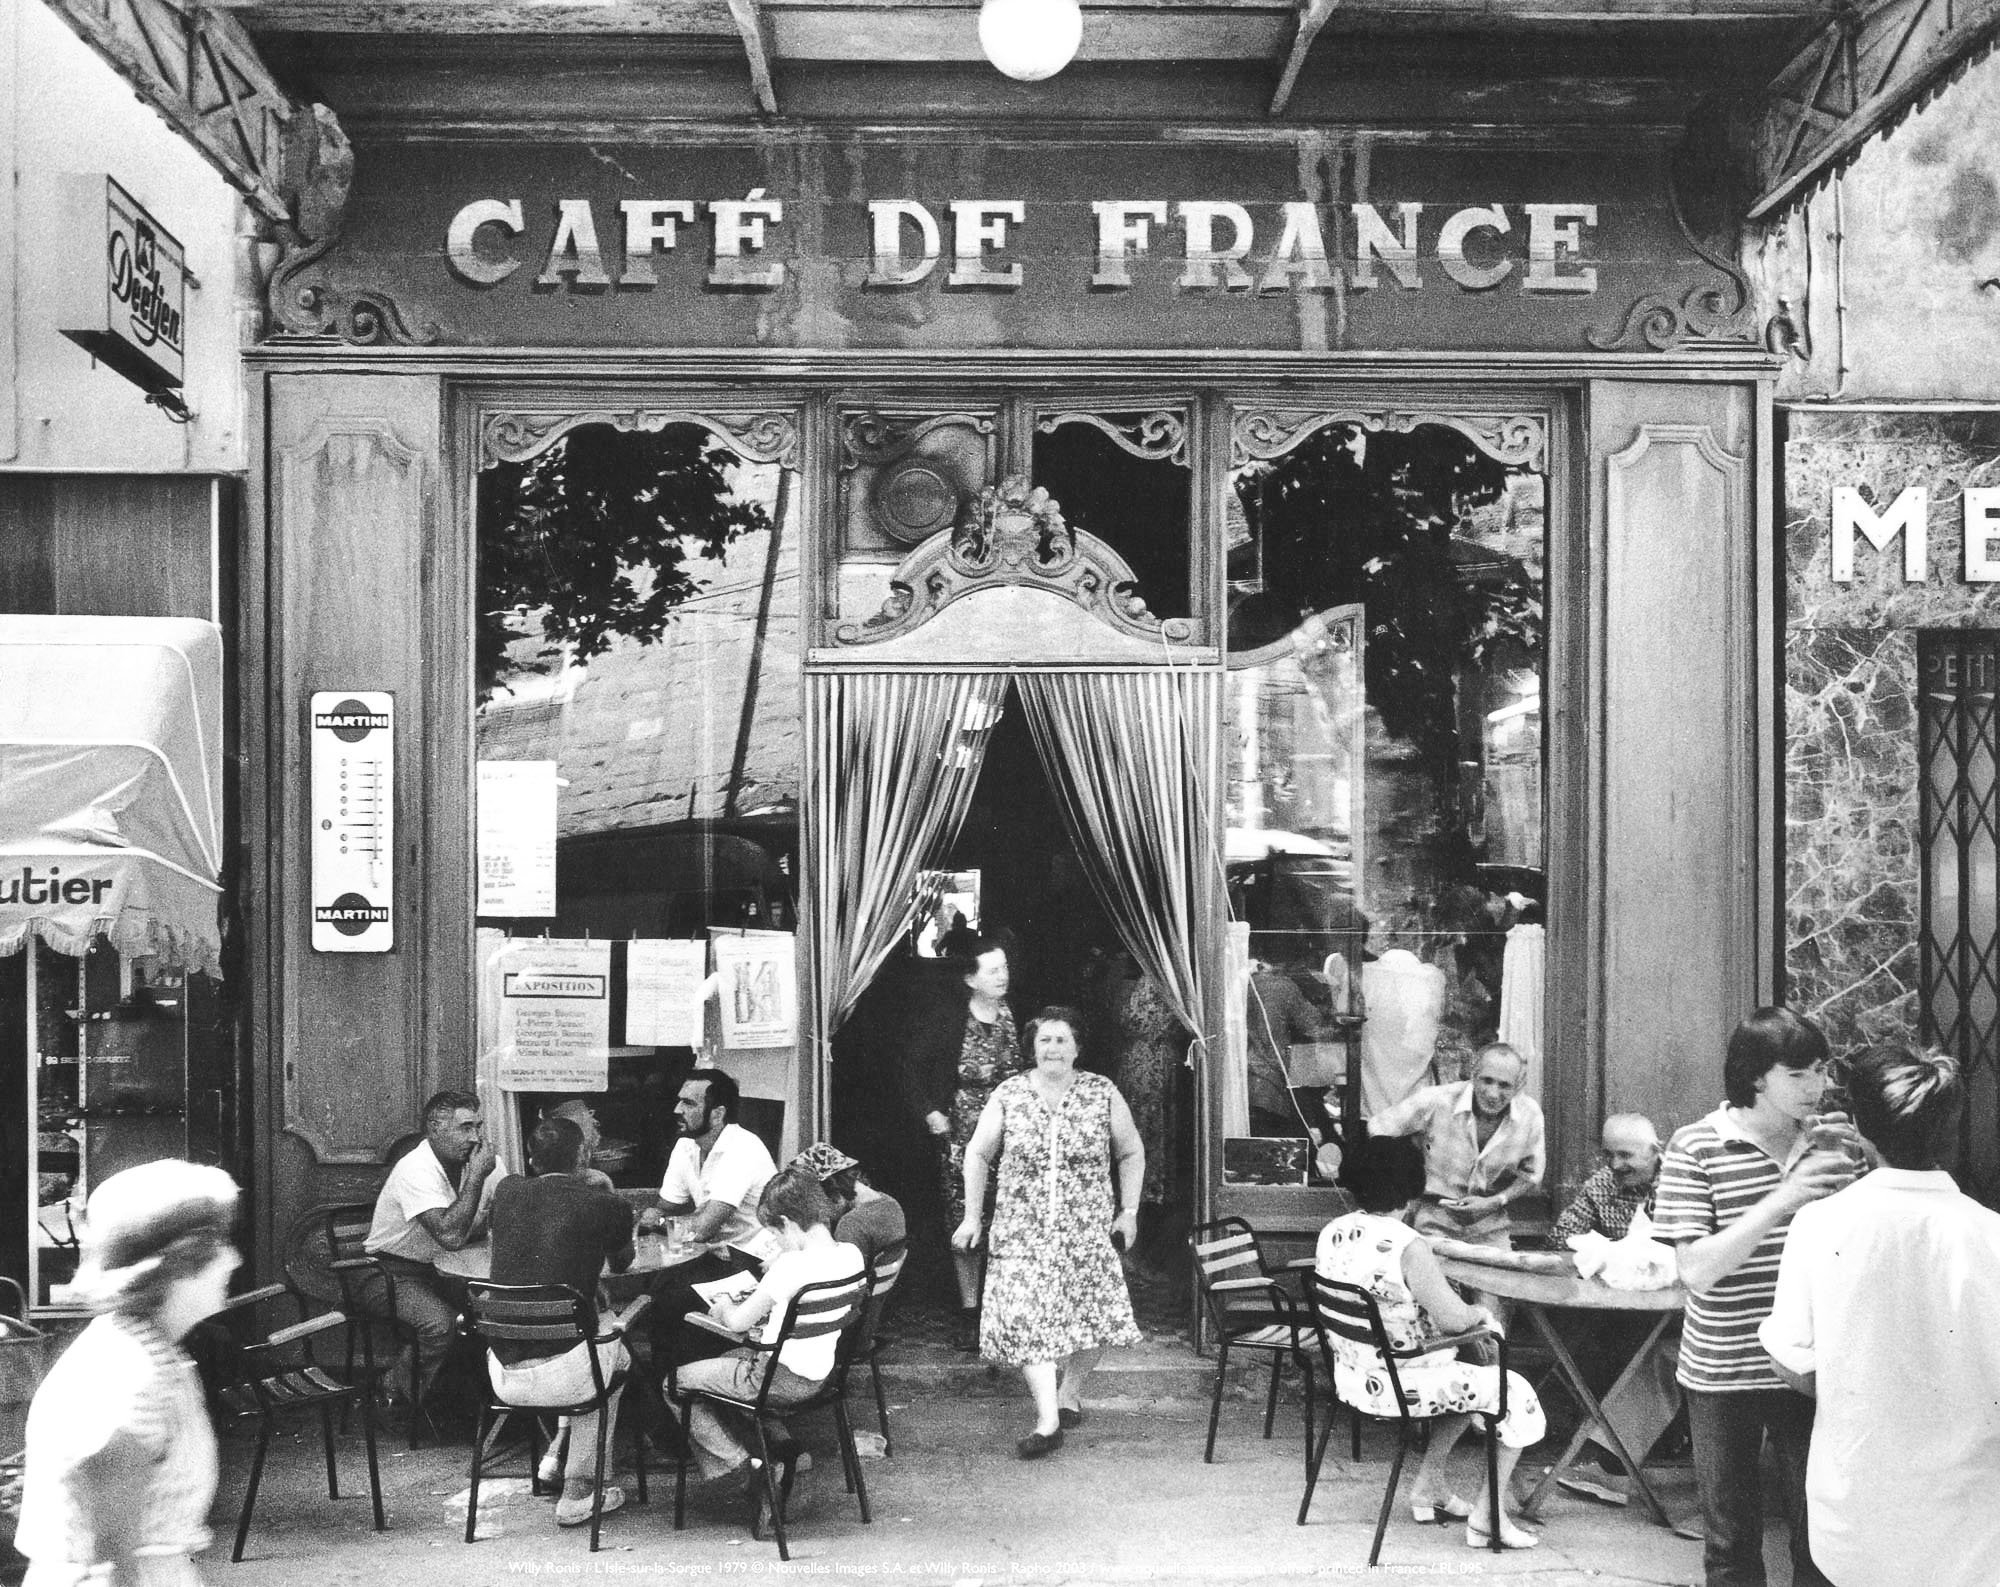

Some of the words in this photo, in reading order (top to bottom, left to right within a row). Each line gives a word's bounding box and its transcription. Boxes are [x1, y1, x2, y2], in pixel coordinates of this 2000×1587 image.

[446, 188, 784, 287] CAFÉ
[868, 199, 1025, 287] DE
[1090, 200, 1599, 293] FRANCE
[1832, 486, 2000, 582] ME
[316, 715, 389, 728] MARTINI
[316, 909, 388, 921] MARTINI
[514, 981, 596, 992] XPOSITION
